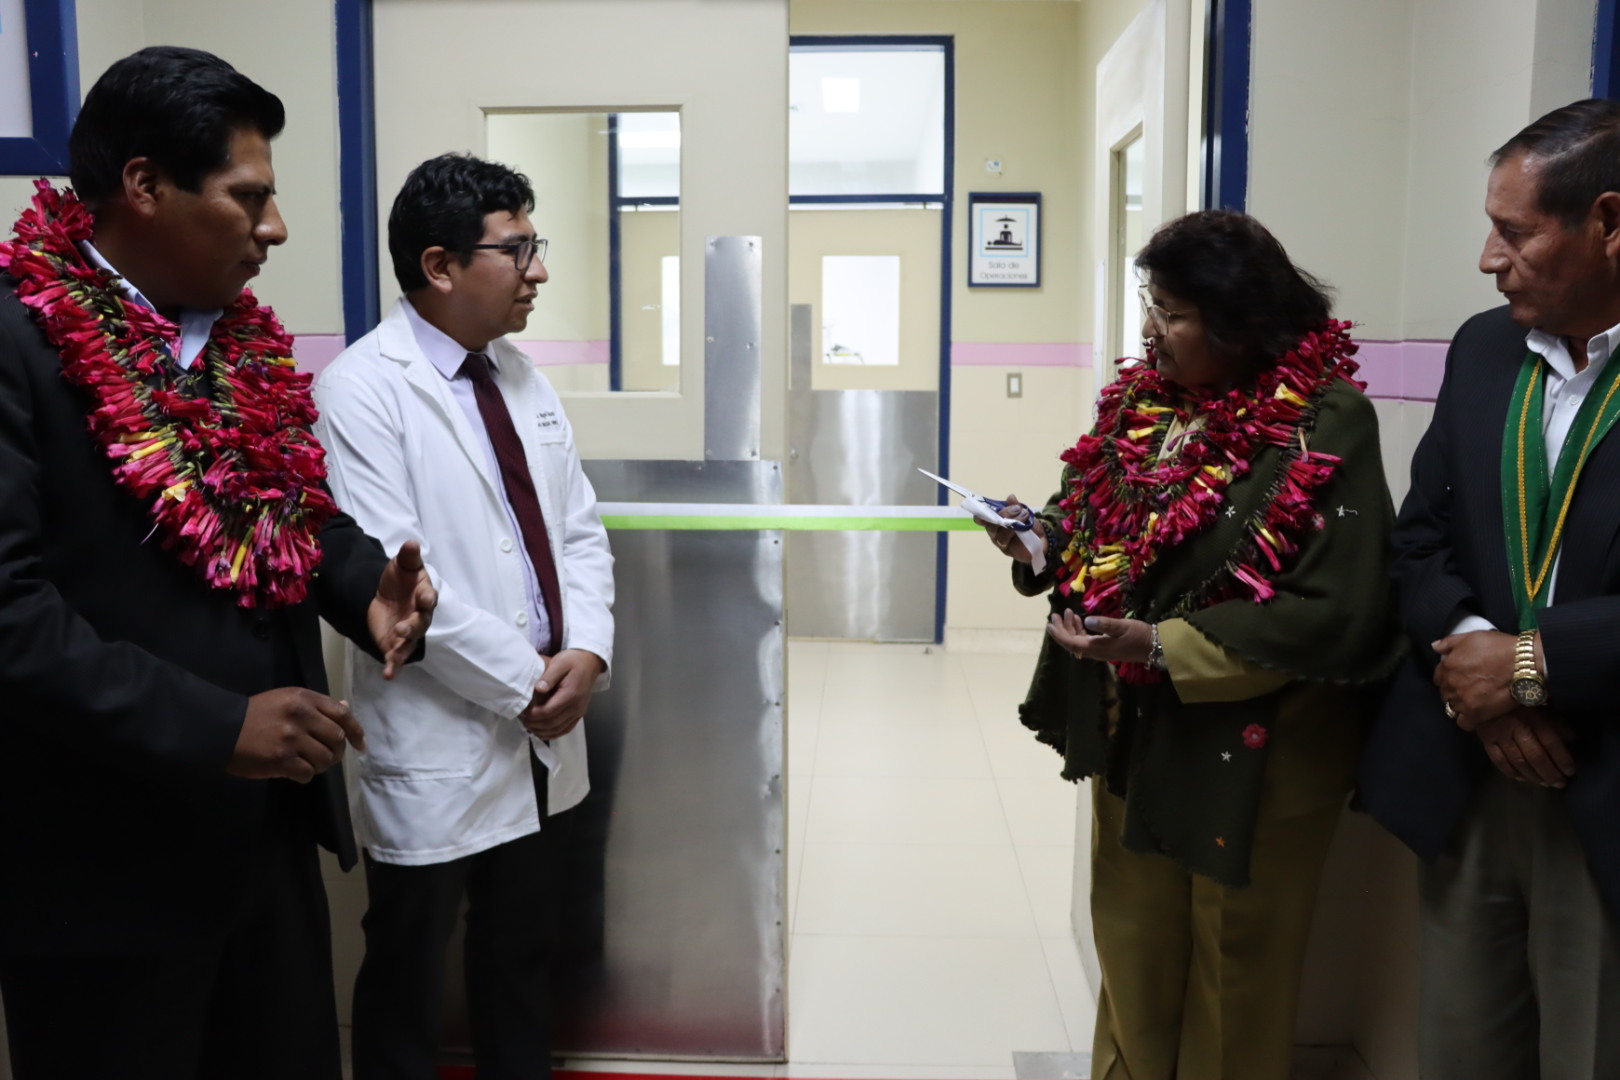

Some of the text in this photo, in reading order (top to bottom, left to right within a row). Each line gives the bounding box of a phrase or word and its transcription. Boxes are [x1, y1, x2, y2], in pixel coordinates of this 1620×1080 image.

[988, 261, 1020, 269] Sala de
[979, 272, 1028, 280] Operaciones
